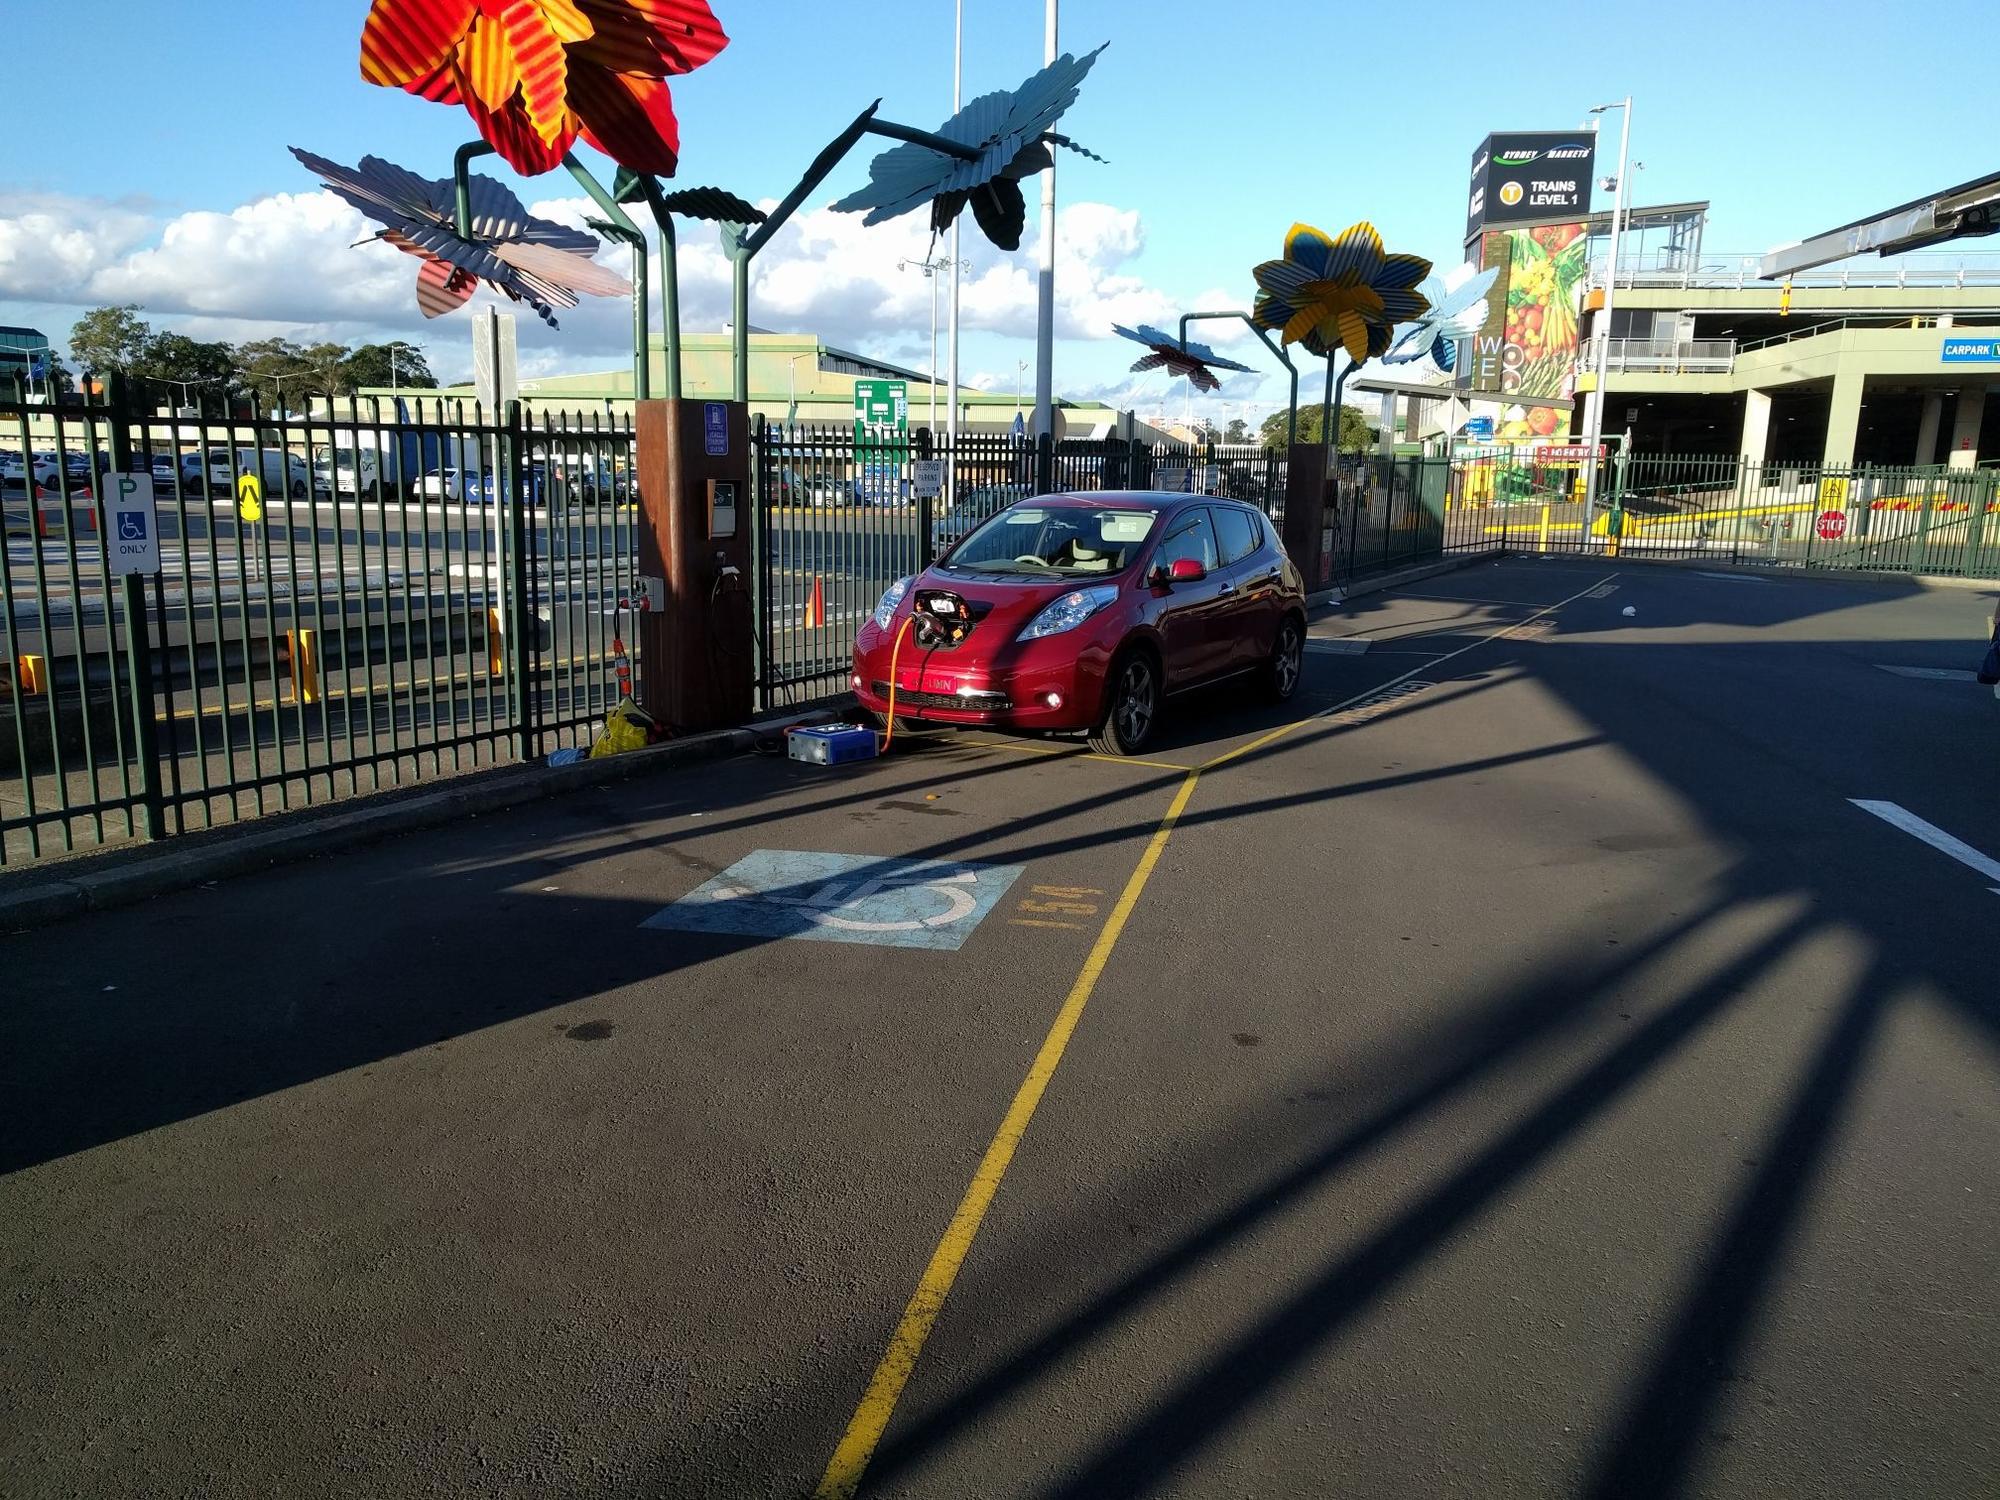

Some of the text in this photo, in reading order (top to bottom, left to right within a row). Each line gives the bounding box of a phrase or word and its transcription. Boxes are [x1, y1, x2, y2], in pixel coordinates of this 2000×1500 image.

[1502, 149, 1589, 160] SYDNEY MARKETS
[1531, 180, 1577, 193] TRAINS
[1529, 194, 1578, 206] LEVEL 1
[1945, 344, 1991, 355] CARPARK
[118, 478, 137, 502] P
[120, 544, 147, 554] ONLY
